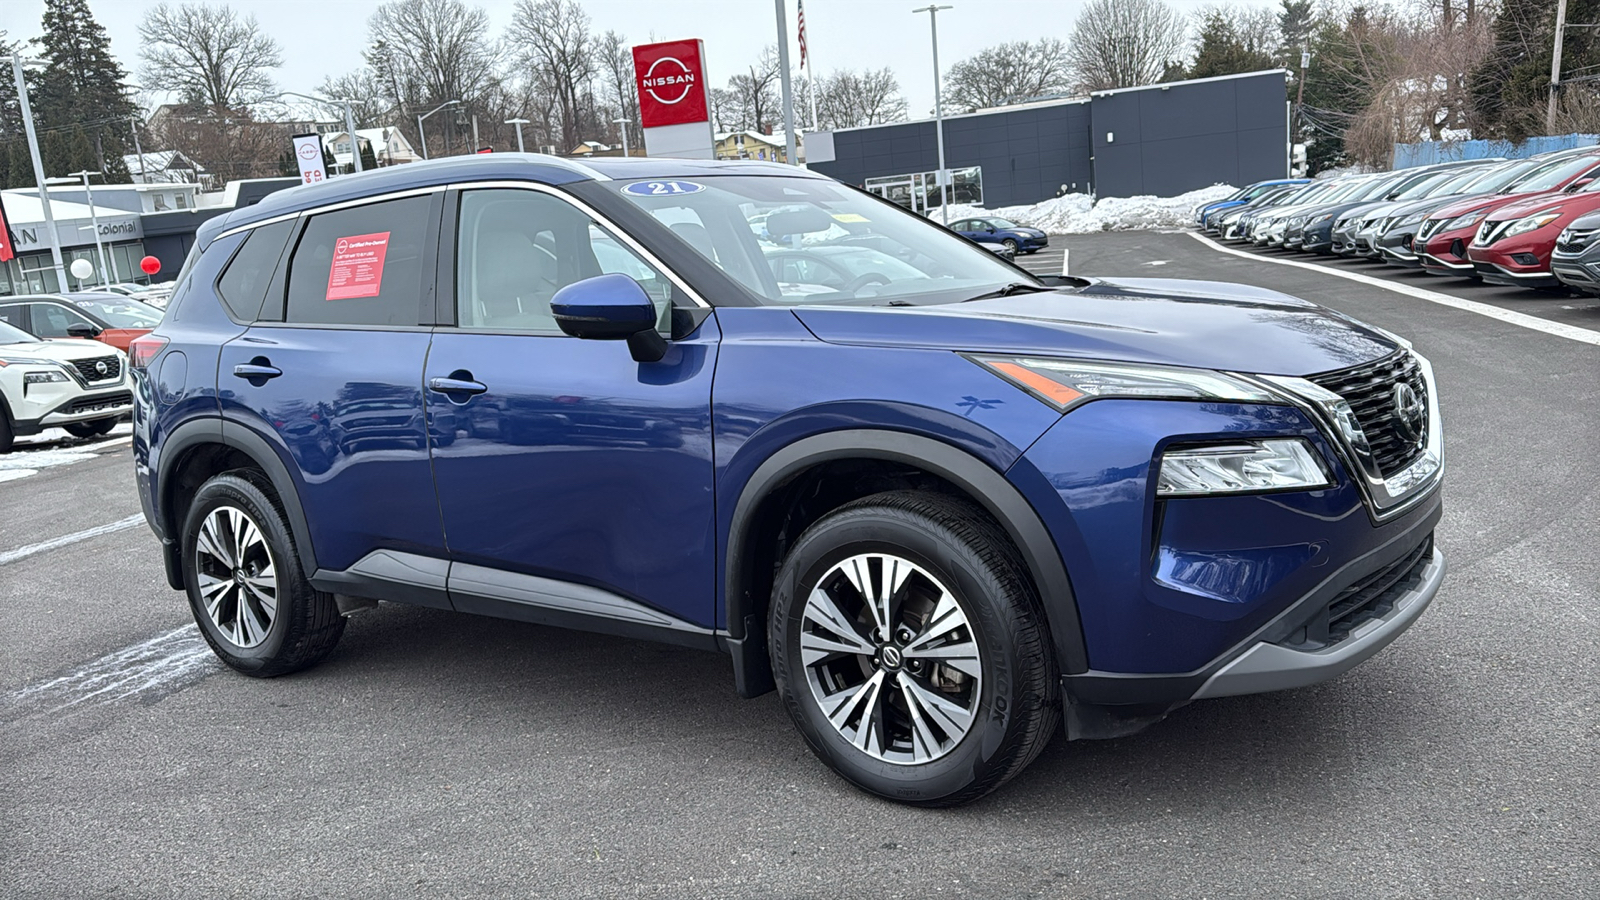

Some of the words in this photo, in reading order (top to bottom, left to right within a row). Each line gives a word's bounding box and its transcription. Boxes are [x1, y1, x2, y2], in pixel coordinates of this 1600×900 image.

[643, 74, 694, 88] NISSAN
[648, 182, 686, 194] 21
[97, 221, 136, 236] Colonial
